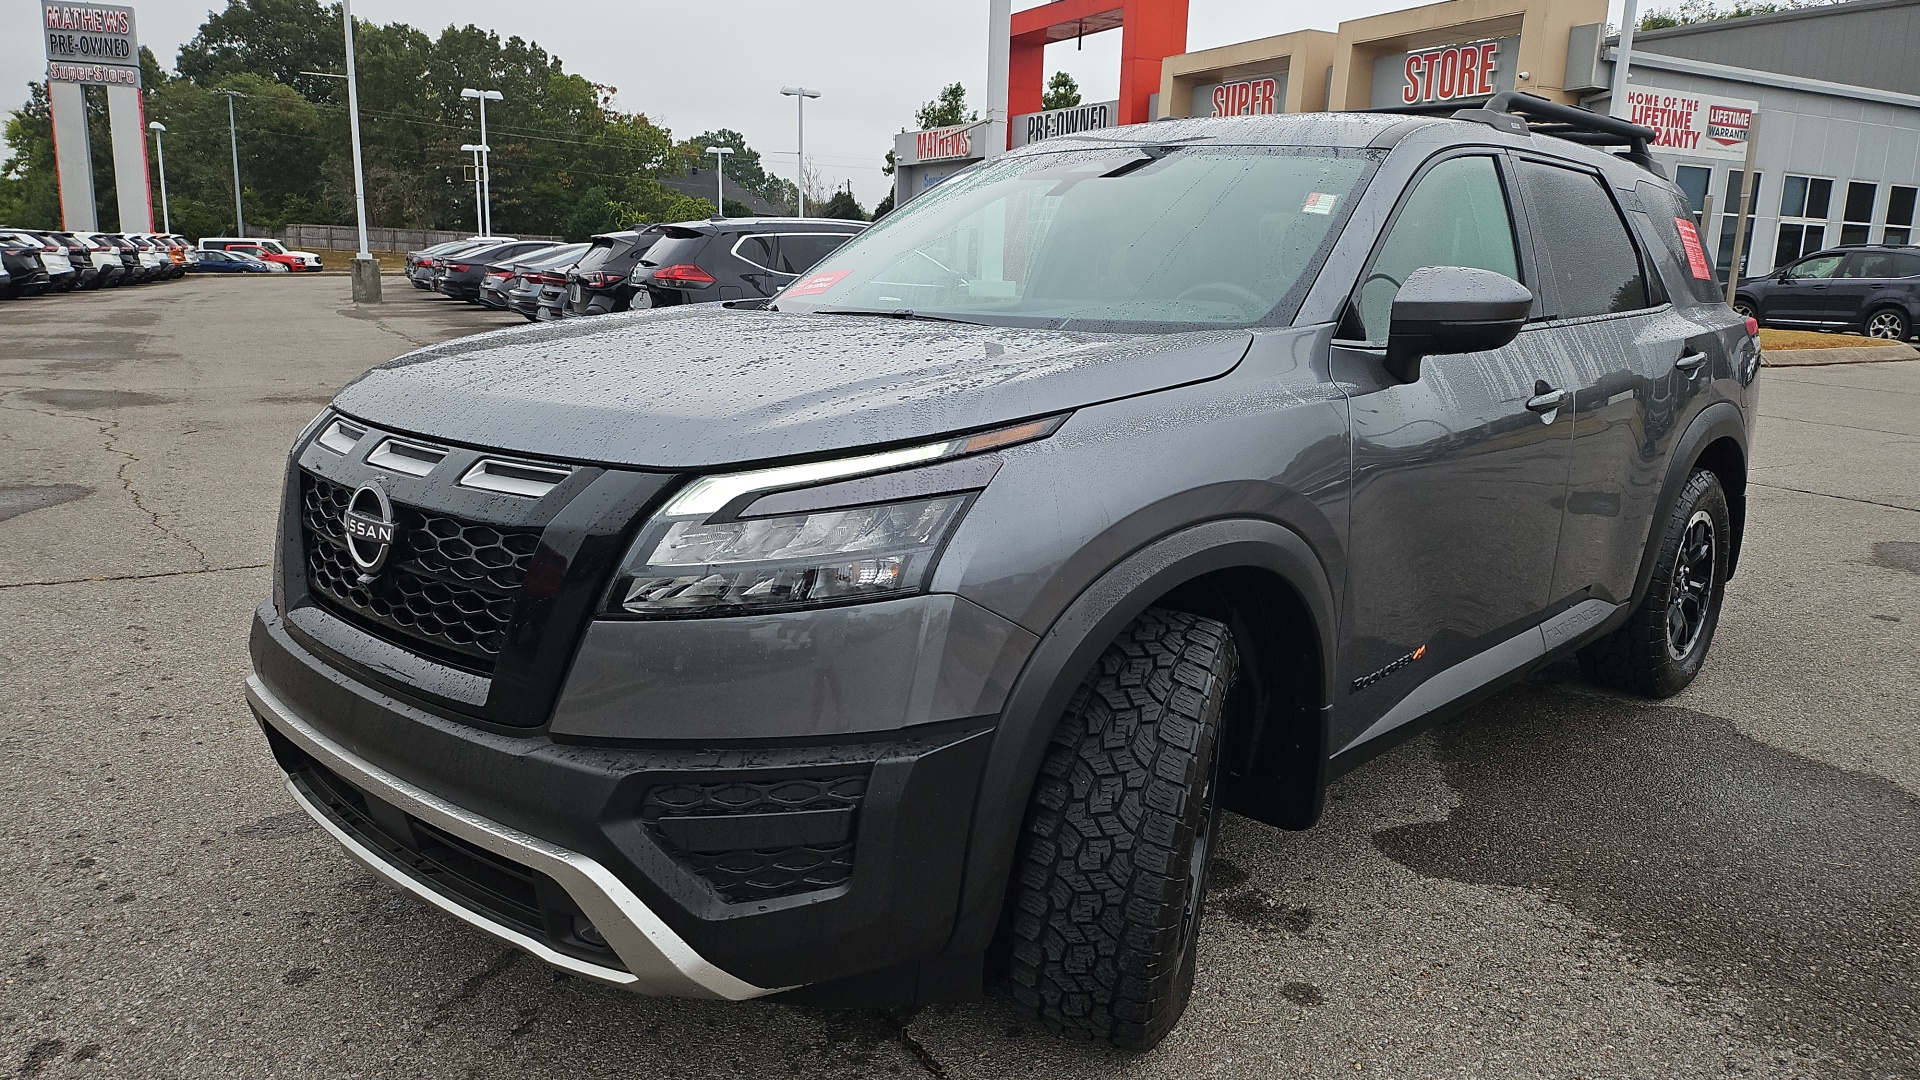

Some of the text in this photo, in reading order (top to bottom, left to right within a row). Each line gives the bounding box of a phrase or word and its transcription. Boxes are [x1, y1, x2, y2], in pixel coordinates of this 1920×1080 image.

[46, 6, 129, 34] MATHEWS
[50, 33, 130, 58] PRE-OWNED
[50, 62, 135, 83] SuperStore
[1402, 42, 1498, 105] STORE
[1211, 78, 1276, 117] SUPER
[1628, 91, 1699, 112] HOME OF THE
[1027, 105, 1109, 144] PRE-OWNED
[1631, 105, 1692, 130] LIFETIME
[1709, 108, 1750, 126] LIFETIME
[916, 129, 970, 160] MATHEWS
[1645, 126, 1701, 149] RANTY
[1708, 126, 1749, 141] WARRANTY
